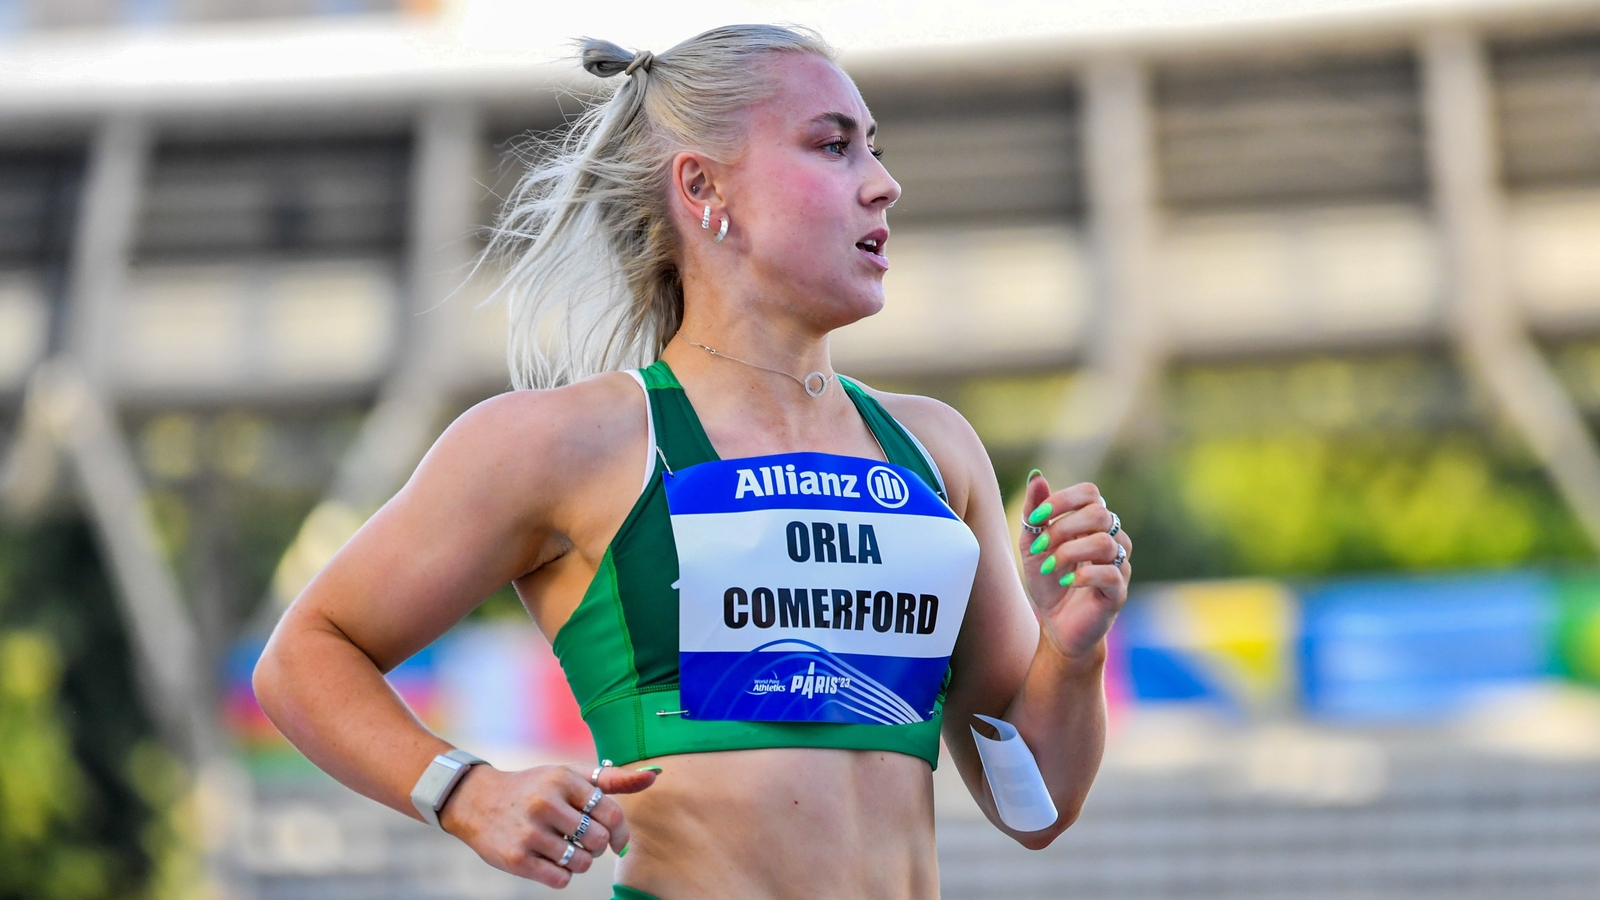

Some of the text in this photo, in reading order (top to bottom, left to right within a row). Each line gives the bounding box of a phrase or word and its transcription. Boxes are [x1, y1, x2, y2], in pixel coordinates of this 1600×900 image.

[735, 464, 861, 499] Allianz
[786, 520, 882, 564] ORLA
[723, 586, 939, 635] COMERFORD
[753, 683, 786, 692] Athletics
